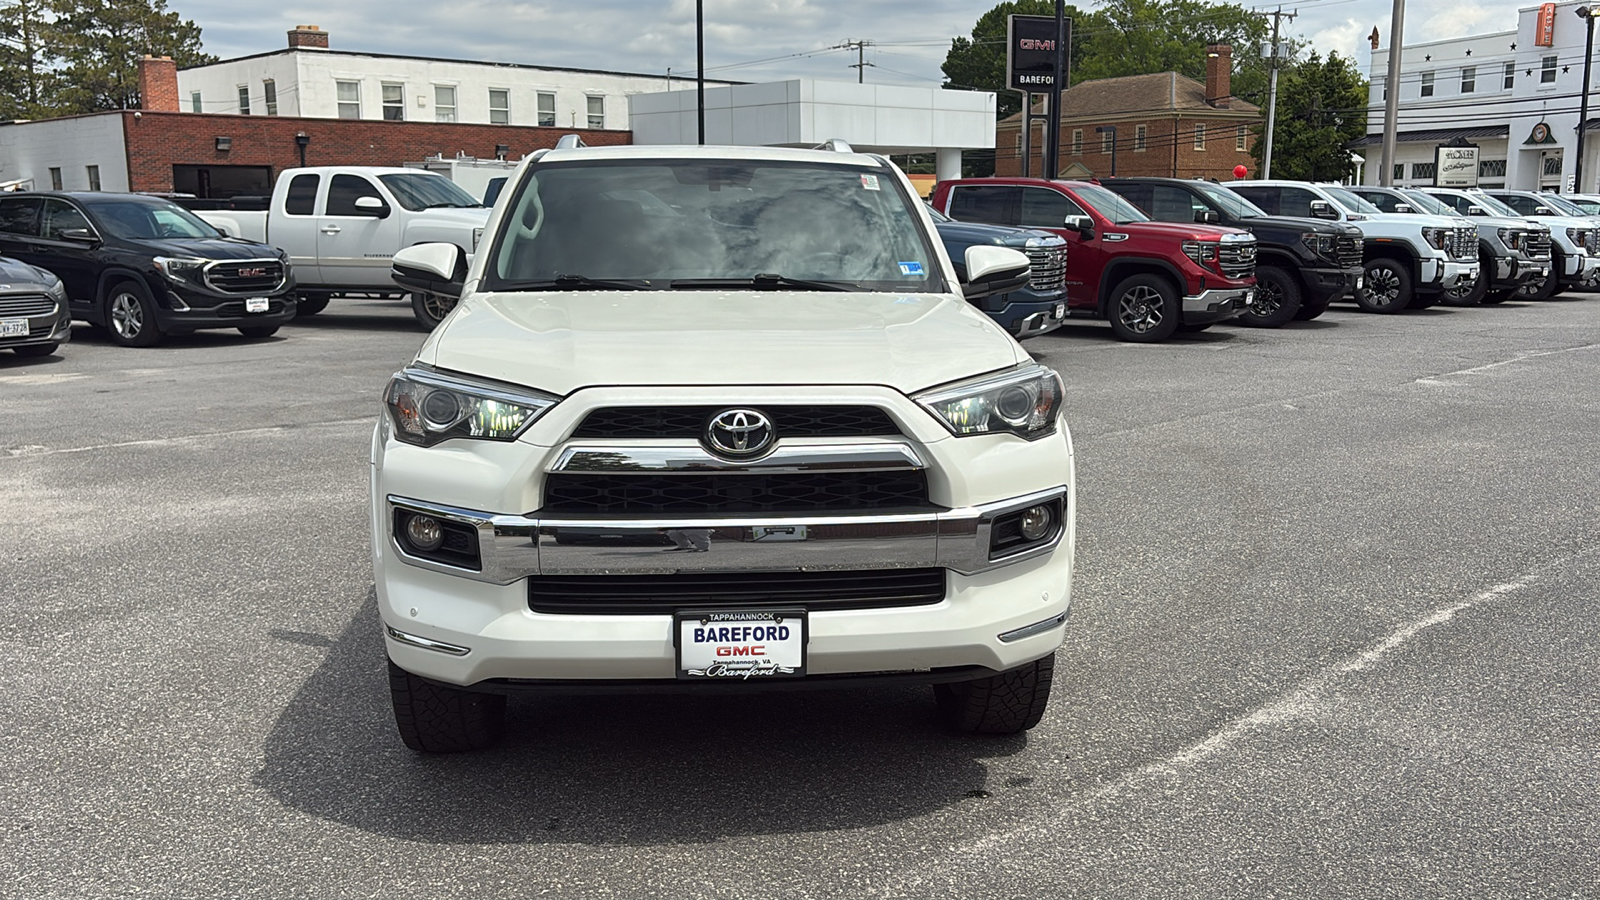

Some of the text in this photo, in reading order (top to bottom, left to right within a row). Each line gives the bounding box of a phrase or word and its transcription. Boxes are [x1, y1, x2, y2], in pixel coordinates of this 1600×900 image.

[1020, 39, 1056, 50] GM
[694, 626, 790, 643] BAREFORD
[716, 645, 765, 656] GMC
[706, 663, 779, 680] Bareford
